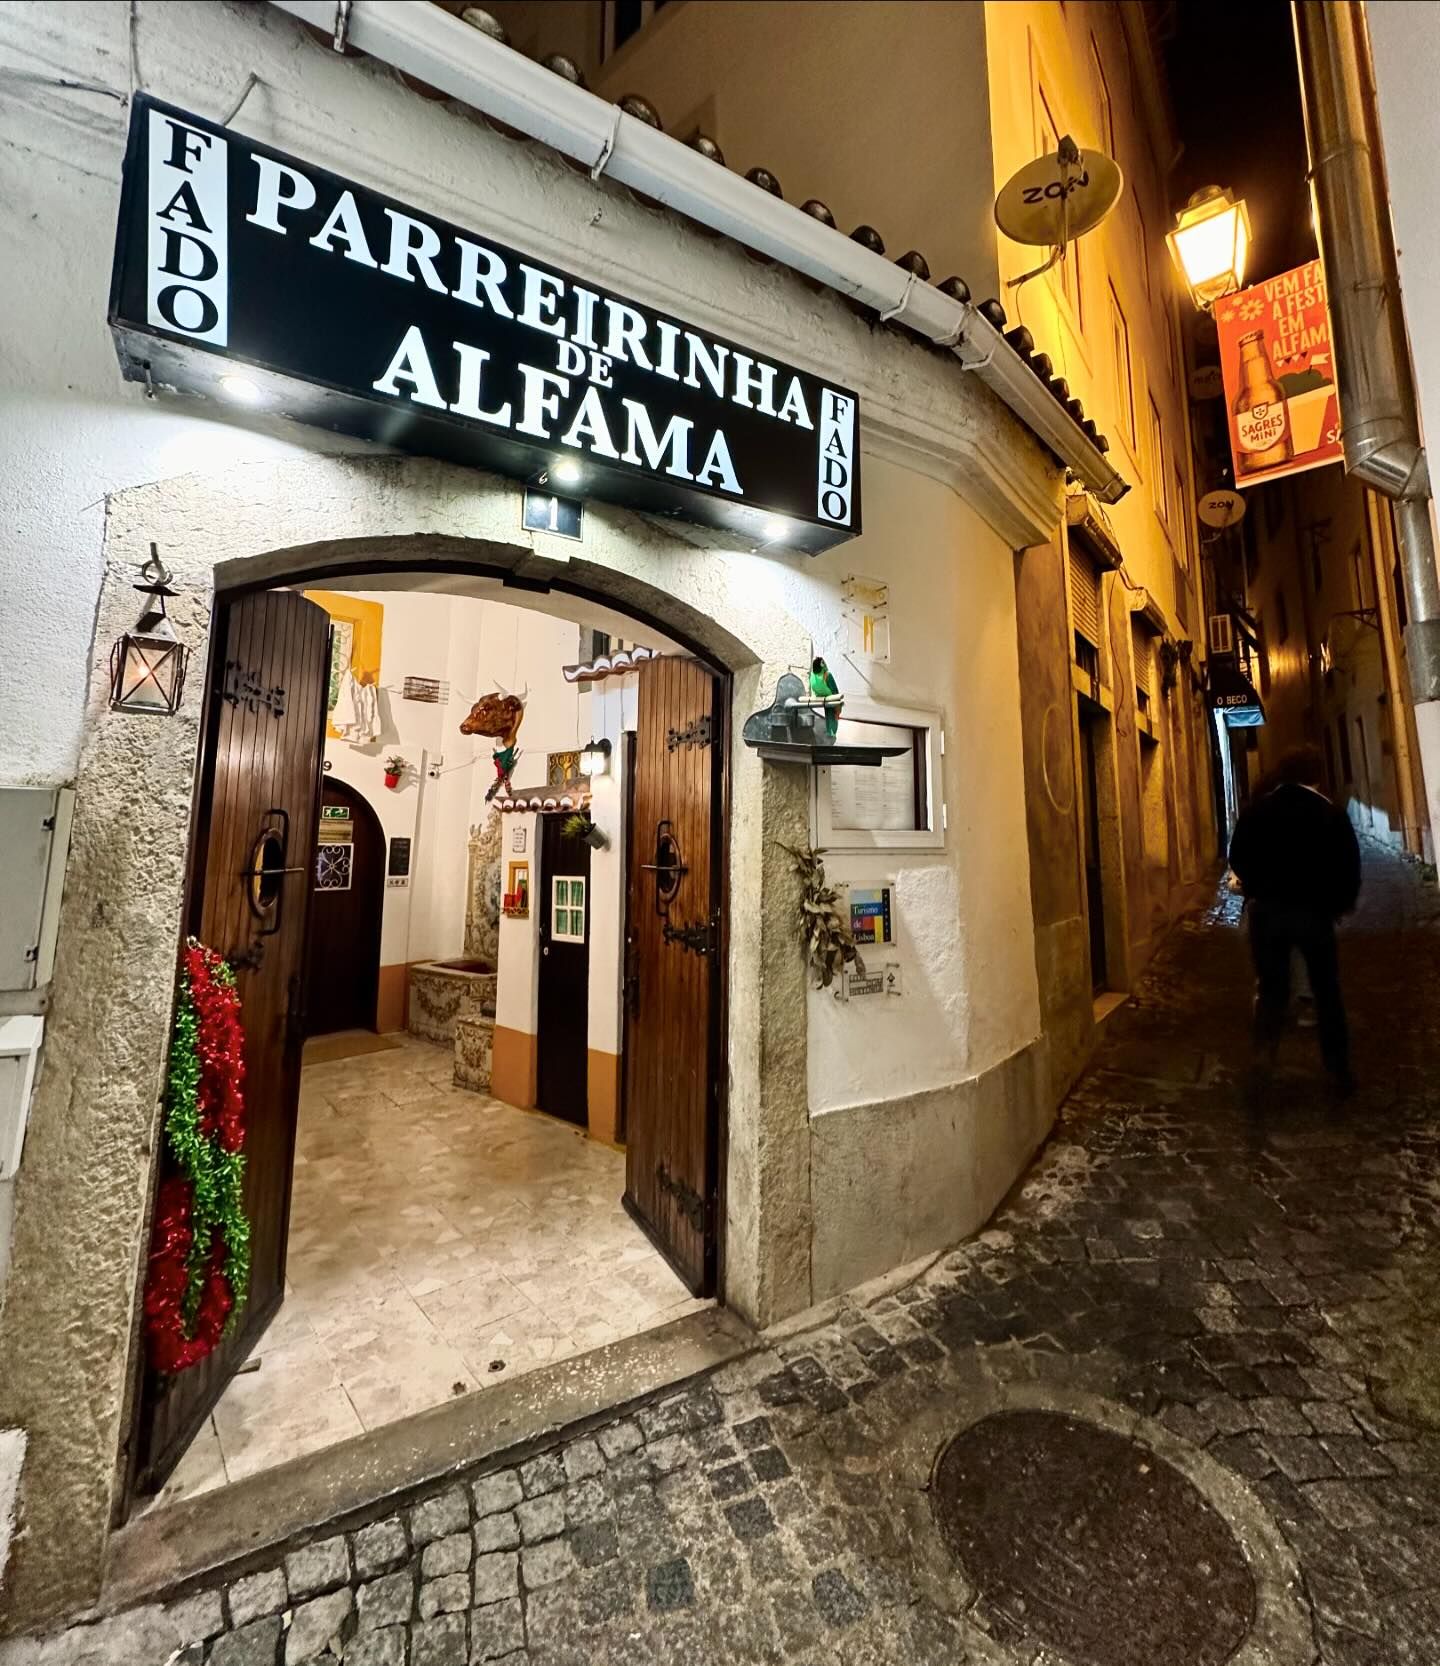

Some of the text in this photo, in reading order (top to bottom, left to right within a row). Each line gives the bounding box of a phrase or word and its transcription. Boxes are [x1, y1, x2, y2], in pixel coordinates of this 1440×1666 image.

[156, 120, 219, 333] FADO
[246, 153, 814, 430] PARREIRINHA
[1264, 272, 1300, 302] VEM
[1272, 301, 1283, 320] A
[1280, 311, 1304, 338] EM
[1272, 323, 1329, 361] ALFAM
[556, 339, 613, 389] DE
[373, 325, 743, 495] ALFAMA
[1241, 414, 1283, 437] SAGRES
[822, 393, 849, 520] FADO
[548, 496, 558, 531] 1
[1217, 695, 1247, 705] O BECO
